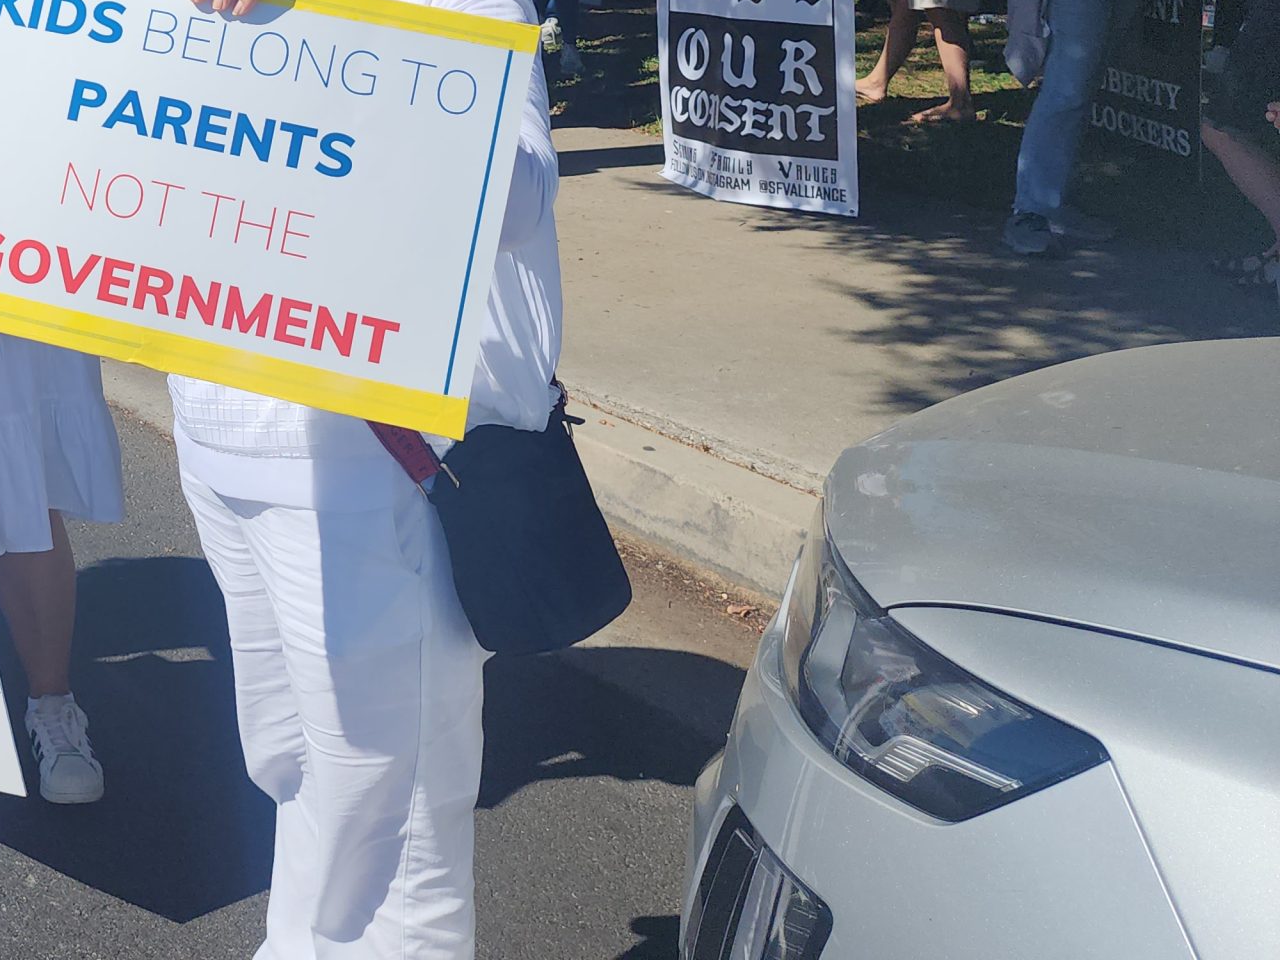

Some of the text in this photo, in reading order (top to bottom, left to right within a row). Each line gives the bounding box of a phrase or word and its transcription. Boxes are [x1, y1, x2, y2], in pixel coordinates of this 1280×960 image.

[141, 8, 380, 97] BELONG
[401, 57, 478, 116] TO
[677, 27, 824, 96] OUR
[66, 78, 356, 178] PARENTS
[59, 161, 316, 259] NOT THE
